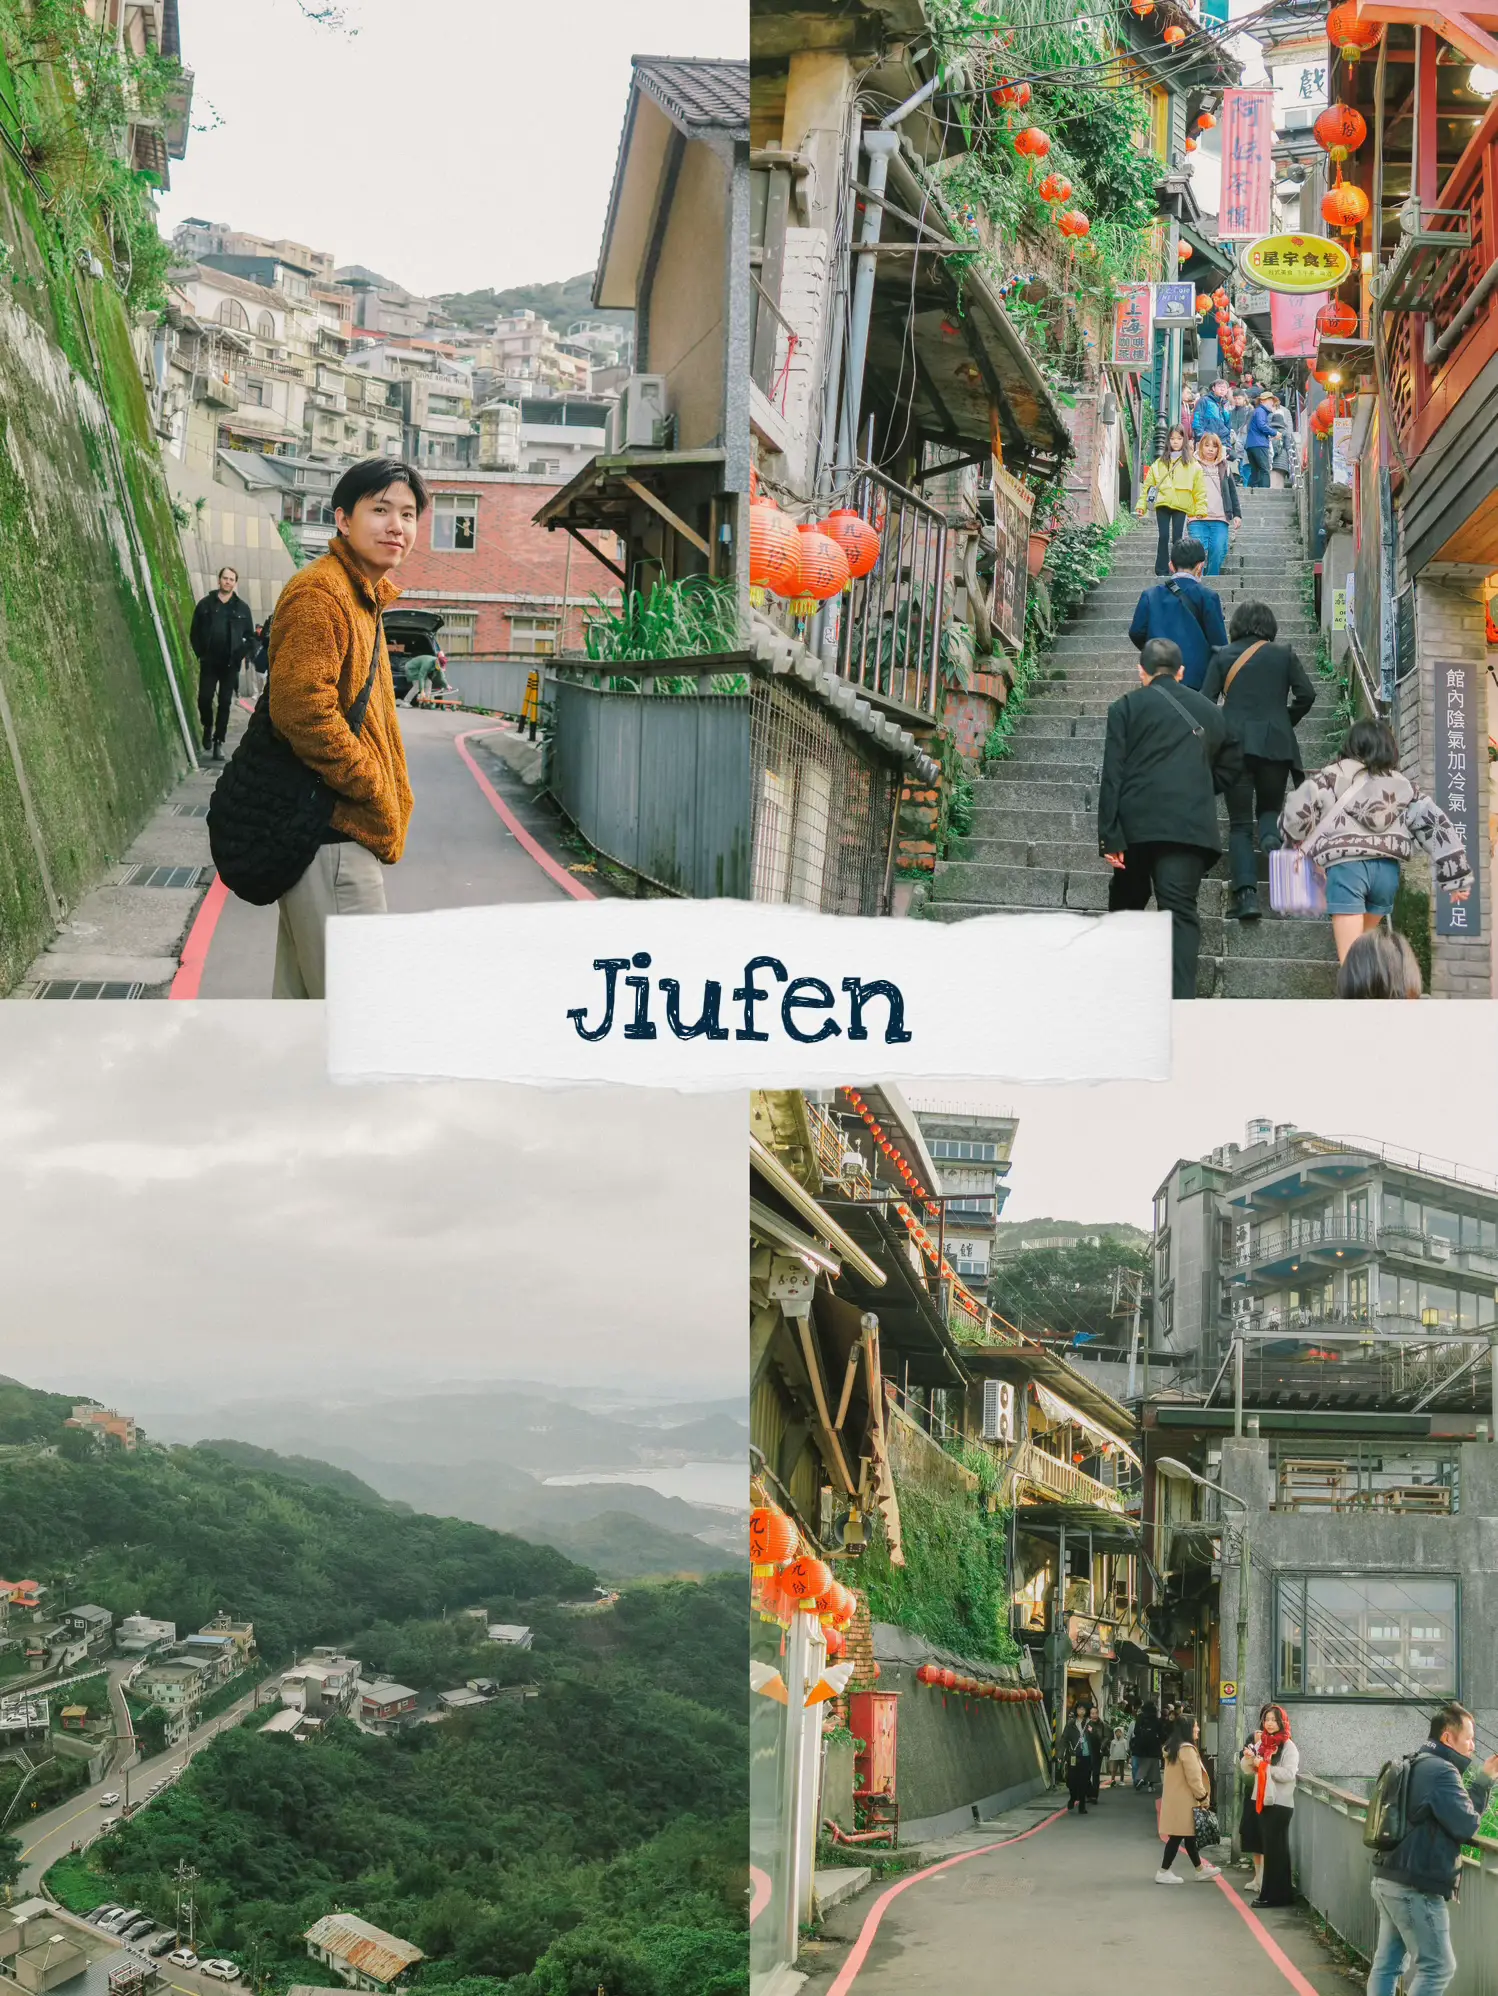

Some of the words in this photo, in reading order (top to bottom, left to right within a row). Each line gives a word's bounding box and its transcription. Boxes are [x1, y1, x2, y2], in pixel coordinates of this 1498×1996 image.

[1226, 95, 1264, 228] 阿妹茶樓
[1263, 251, 1340, 267] 星宇食堂
[1446, 669, 1467, 812] 館內陰氣加冷氣
[792, 1564, 806, 1594] 九份
